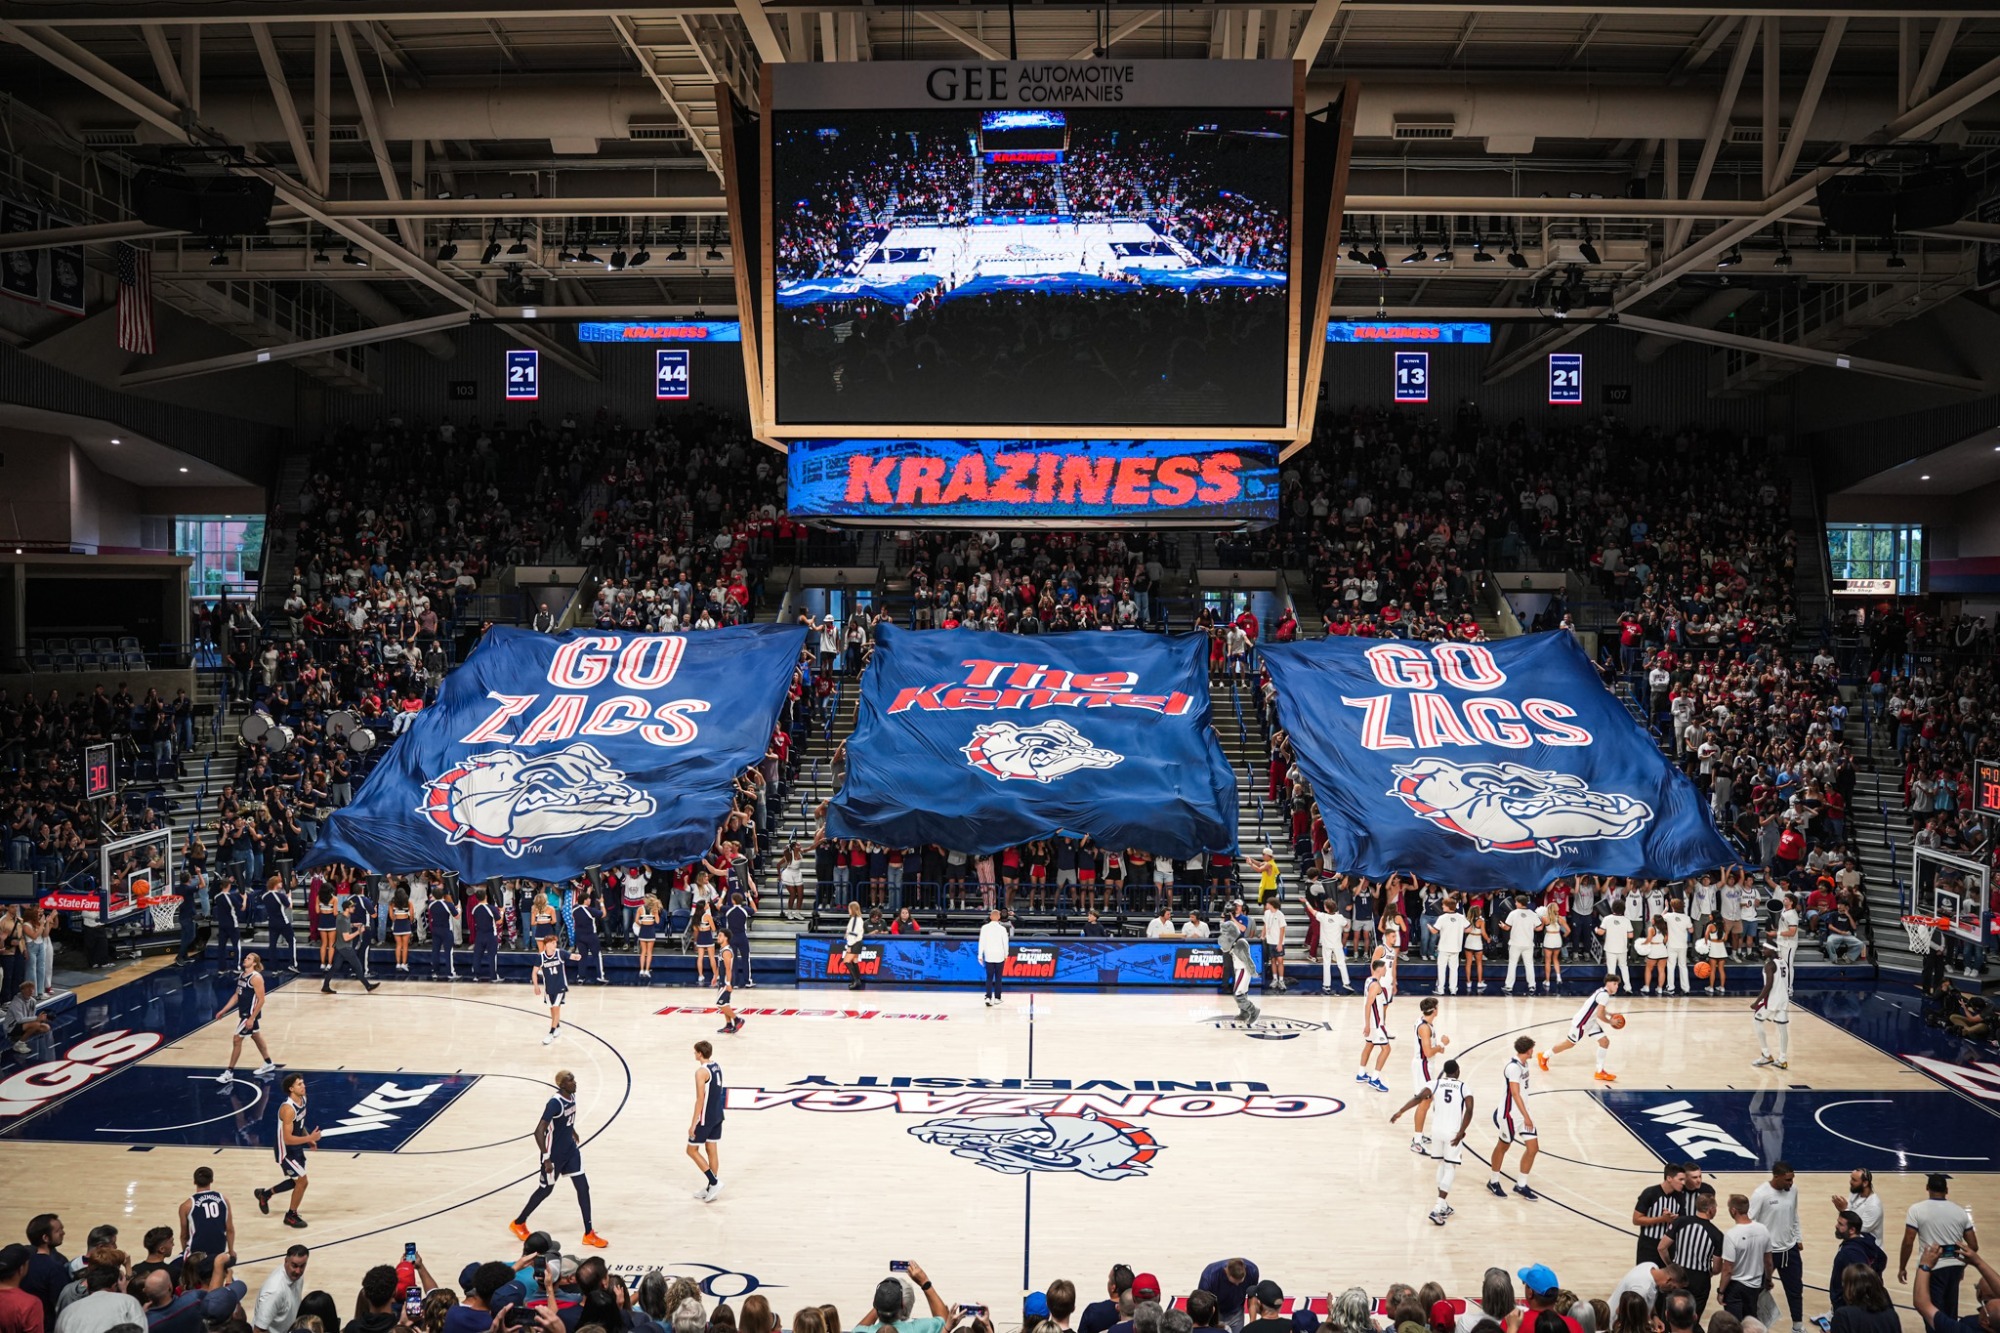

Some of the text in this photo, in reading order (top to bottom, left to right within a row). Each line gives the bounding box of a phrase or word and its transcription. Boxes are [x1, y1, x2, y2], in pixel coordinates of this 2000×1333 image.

[926, 66, 1134, 101] GEE AUTOMOTIVE
[1018, 86, 1124, 102] COMPANIES
[623, 327, 708, 338] KRAZINESS
[1354, 327, 1441, 339] KRAZINESS
[510, 366, 535, 382] 21
[659, 365, 687, 381] 44
[1398, 368, 1425, 384] 13
[1553, 370, 1579, 386] 21
[456, 385, 474, 396] 103
[1610, 389, 1627, 400] 107
[844, 452, 1243, 505] KRAZINESS
[547, 636, 688, 690] GO
[1364, 643, 1507, 691] GO
[961, 659, 1139, 692] The
[887, 682, 1194, 716] Kennel
[459, 691, 711, 747] ZAGS
[1340, 692, 1594, 750] ZAGS
[90, 765, 107, 791] 30
[1983, 782, 2000, 810] 30
[1002, 956, 1056, 976] Kennel
[785, 1075, 1269, 1092] UNIVERSITY
[722, 1087, 1346, 1118] GONZAGA
[1444, 1089, 1453, 1103] 5
[202, 1201, 220, 1219] 10
